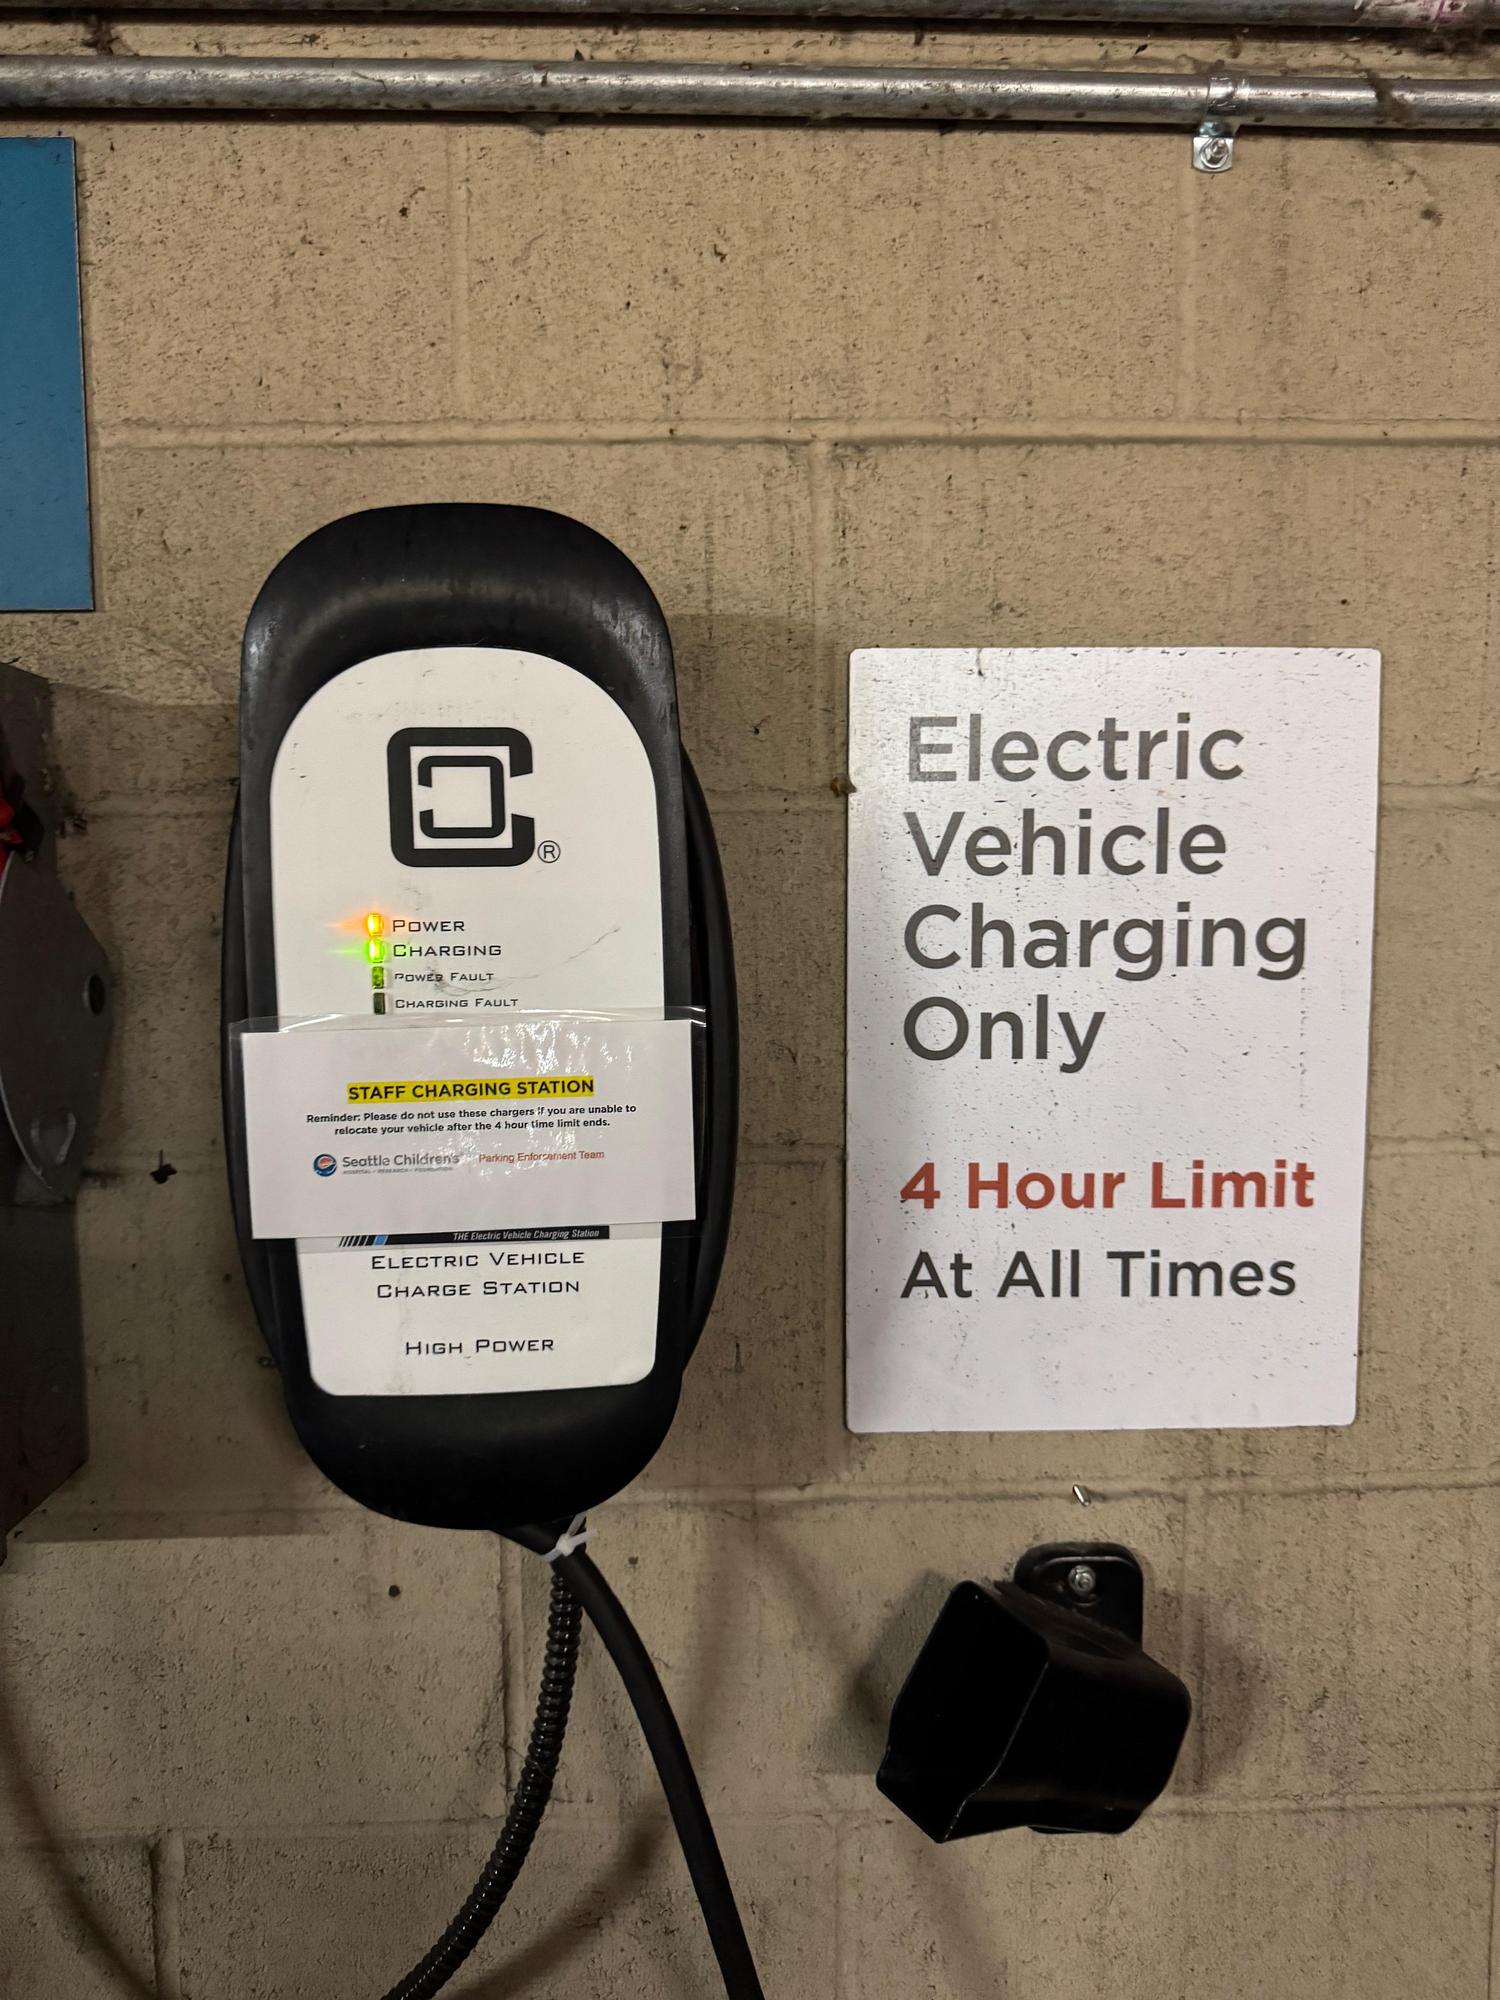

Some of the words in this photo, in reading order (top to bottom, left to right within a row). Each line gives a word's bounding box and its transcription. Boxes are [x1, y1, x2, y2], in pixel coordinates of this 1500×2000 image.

[907, 712, 1244, 783] Electric
[904, 806, 1227, 878] Vehicle
[392, 919, 466, 933] POWER
[904, 901, 1307, 982] Charging
[392, 944, 502, 958] CHARGING
[394, 973, 443, 983] POWER
[450, 972, 495, 982] FAULT
[395, 998, 469, 1009] CHARGING
[475, 998, 519, 1008] FAULT
[904, 994, 1106, 1073] Only
[349, 1085, 405, 1100] STAFF
[412, 1081, 511, 1097] CHARGING
[517, 1080, 594, 1095] STATION
[306, 1113, 361, 1123] Reminder:
[364, 1112, 398, 1121] Please
[400, 1111, 415, 1120] do
[417, 1110, 435, 1119] not
[438, 1110, 456, 1119] use
[458, 1109, 487, 1118] these
[490, 1108, 535, 1118] chargers
[537, 1106, 544, 1115] if
[547, 1107, 566, 1117] you
[569, 1106, 585, 1114] are
[588, 1104, 623, 1114] unable
[625, 1105, 637, 1113] to
[334, 1125, 378, 1135] relocate
[380, 1125, 404, 1135] your
[407, 1123, 445, 1133] vehicle
[446, 1122, 472, 1131] after
[475, 1121, 492, 1130] the
[494, 1121, 502, 1129] 4
[504, 1120, 528, 1129] hour
[531, 1119, 554, 1128] time
[557, 1118, 581, 1127] limit
[583, 1118, 611, 1127] ends.
[342, 1155, 391, 1168] Seattle
[479, 1154, 515, 1163] Parking
[517, 1152, 577, 1161] Enforcement
[578, 1151, 605, 1160] Team
[900, 1162, 940, 1209] 4
[967, 1162, 1125, 1209] Hour
[1151, 1159, 1316, 1208] Limit
[452, 1232, 470, 1241] THE
[470, 1231, 501, 1240] Electric
[502, 1231, 532, 1240] Vehicle
[533, 1230, 570, 1240] Charging
[571, 1229, 600, 1238] Station
[371, 1255, 479, 1270] ELECTRIC
[489, 1252, 585, 1266] VEHICLE
[900, 1250, 973, 1299] At
[997, 1249, 1081, 1298] All
[1107, 1248, 1296, 1298] Times
[377, 1283, 472, 1299] CHARGE
[483, 1280, 580, 1296] STATION
[405, 1341, 463, 1355] HIGH
[475, 1338, 555, 1353] POWER
